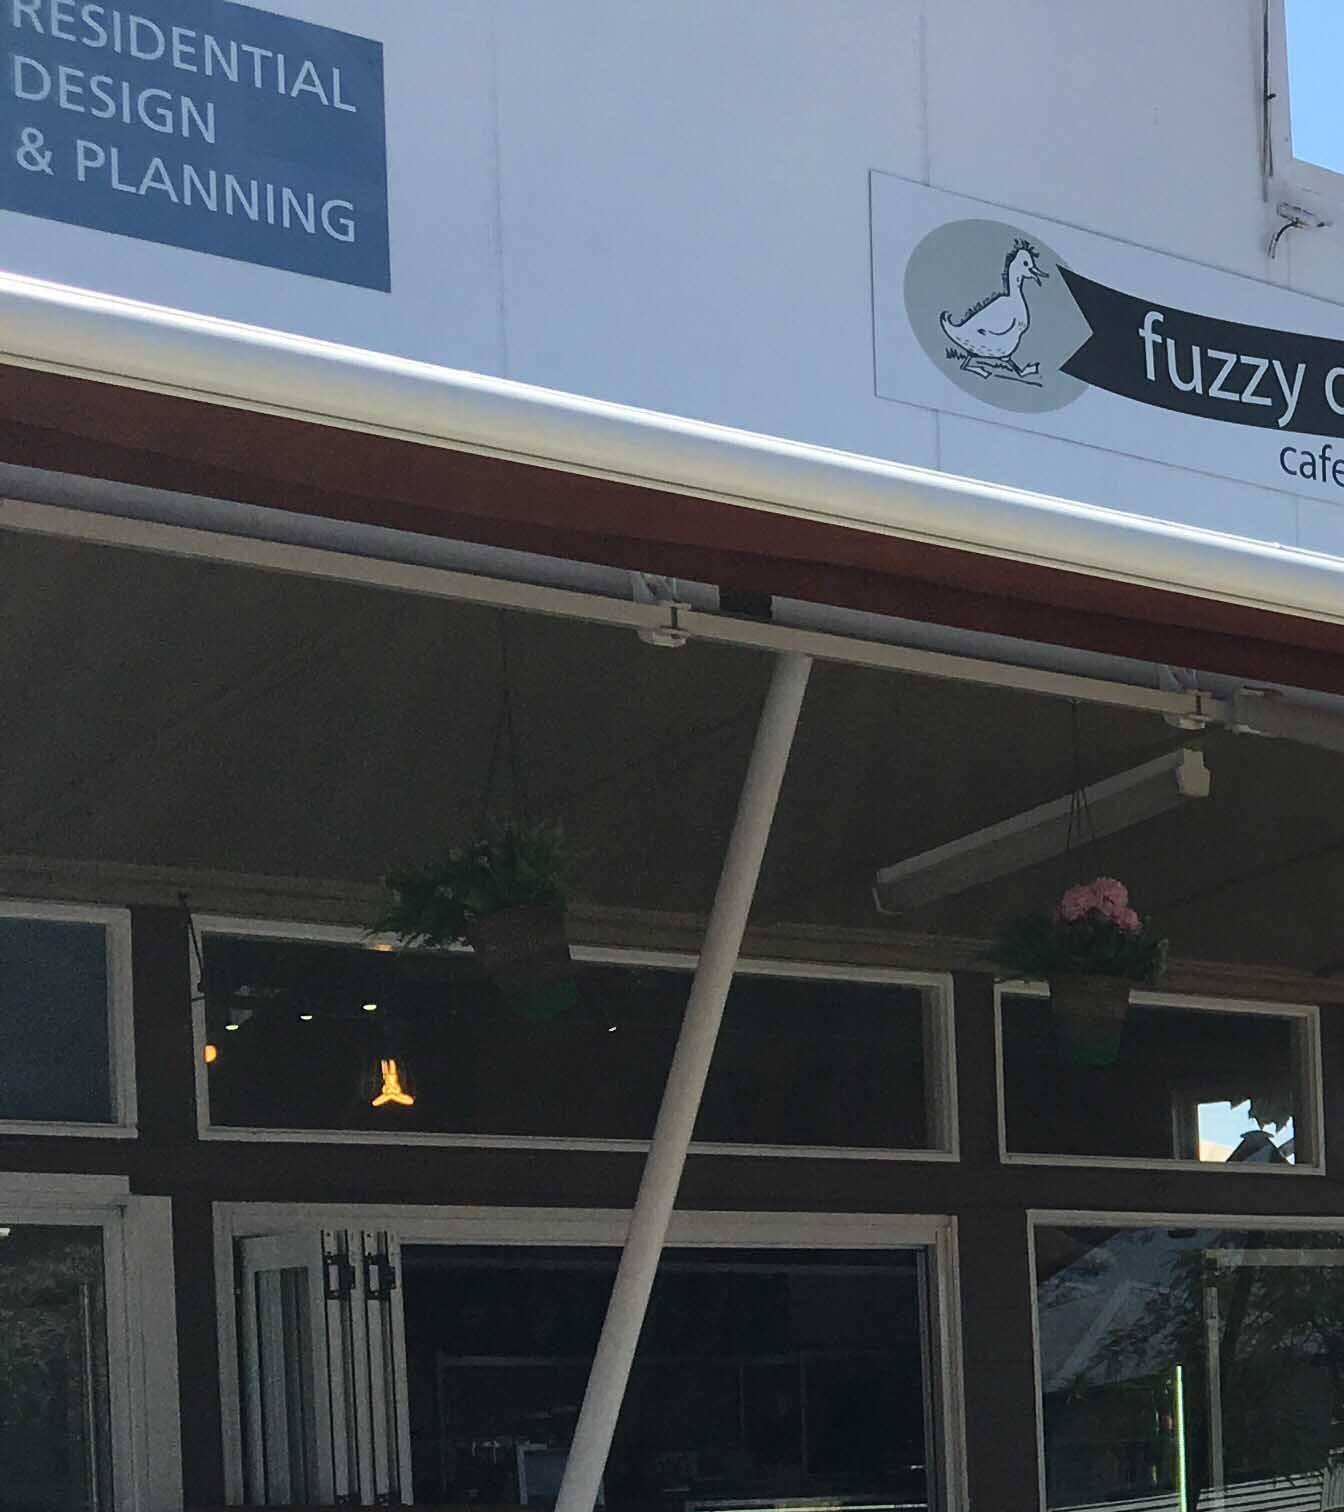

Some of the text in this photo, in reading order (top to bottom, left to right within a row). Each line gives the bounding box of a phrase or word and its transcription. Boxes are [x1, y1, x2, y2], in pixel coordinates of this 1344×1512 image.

[11, 0, 357, 112] RESIDENTIAL
[13, 56, 216, 144] DESIGN
[16, 127, 356, 242] & PLANNING
[1138, 311, 1307, 427] fuzzy
